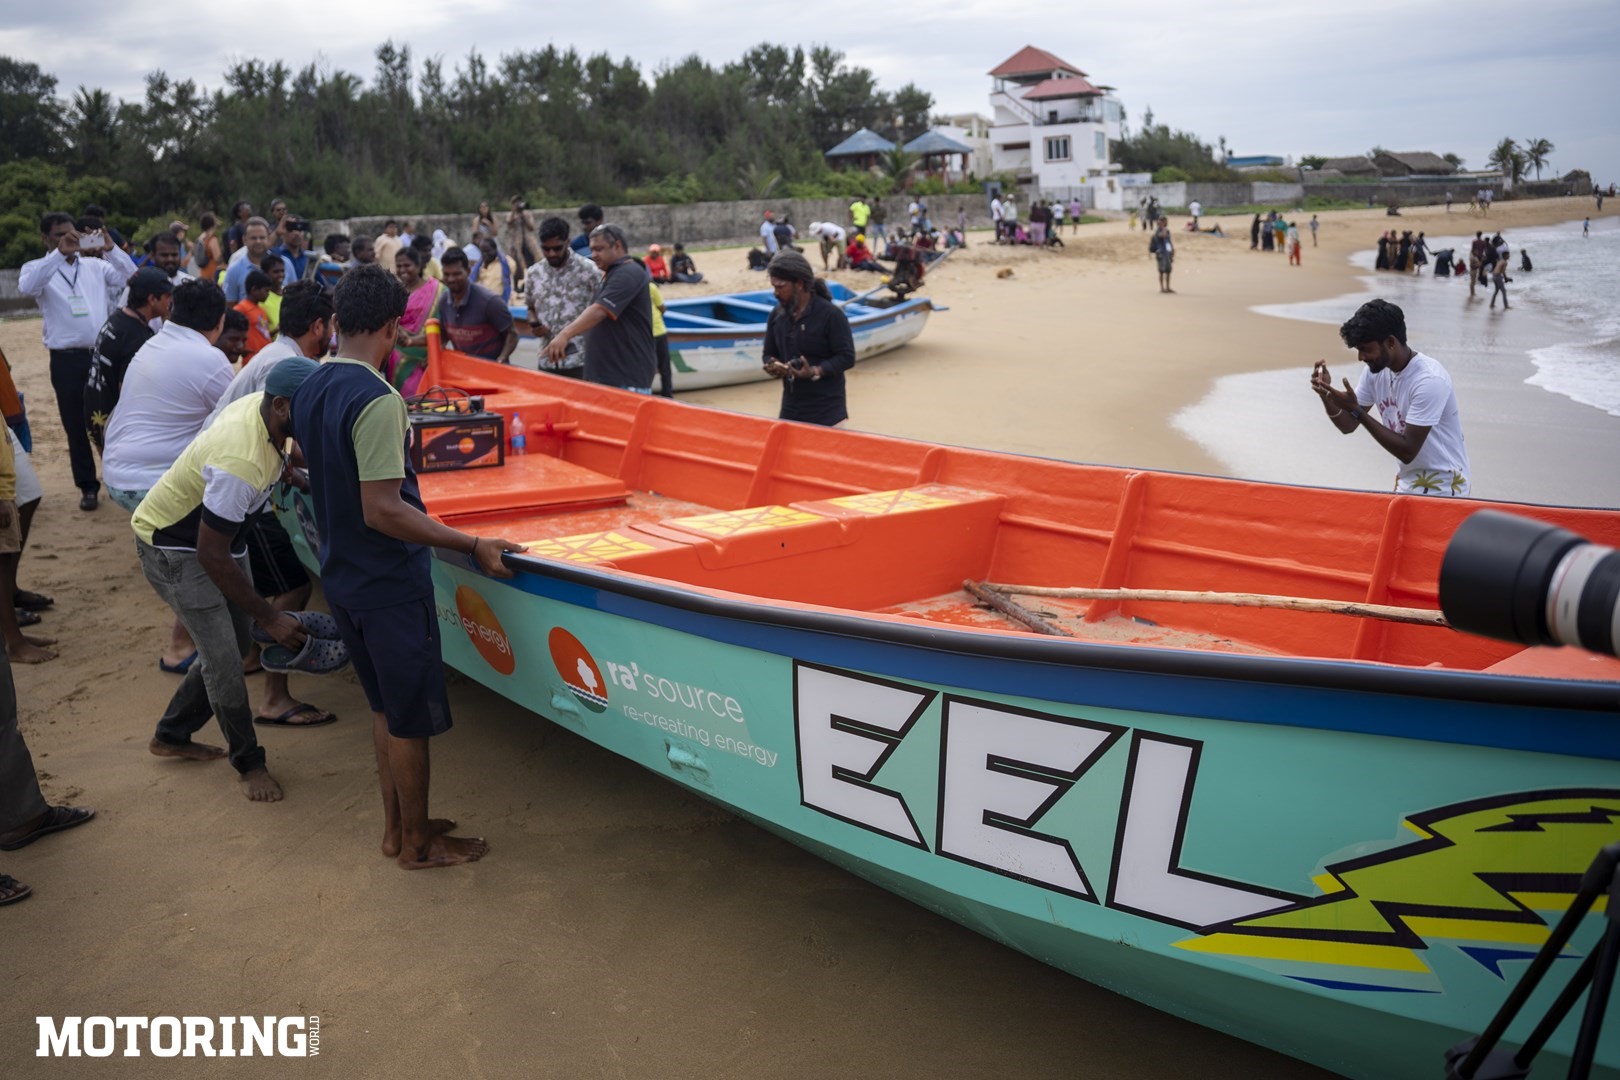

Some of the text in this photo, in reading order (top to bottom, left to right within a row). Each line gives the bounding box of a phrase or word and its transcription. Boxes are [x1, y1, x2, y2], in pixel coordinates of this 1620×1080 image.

[643, 673, 745, 723] source
[623, 704, 778, 768] re-creating energy
[793, 658, 1318, 936] EEL
